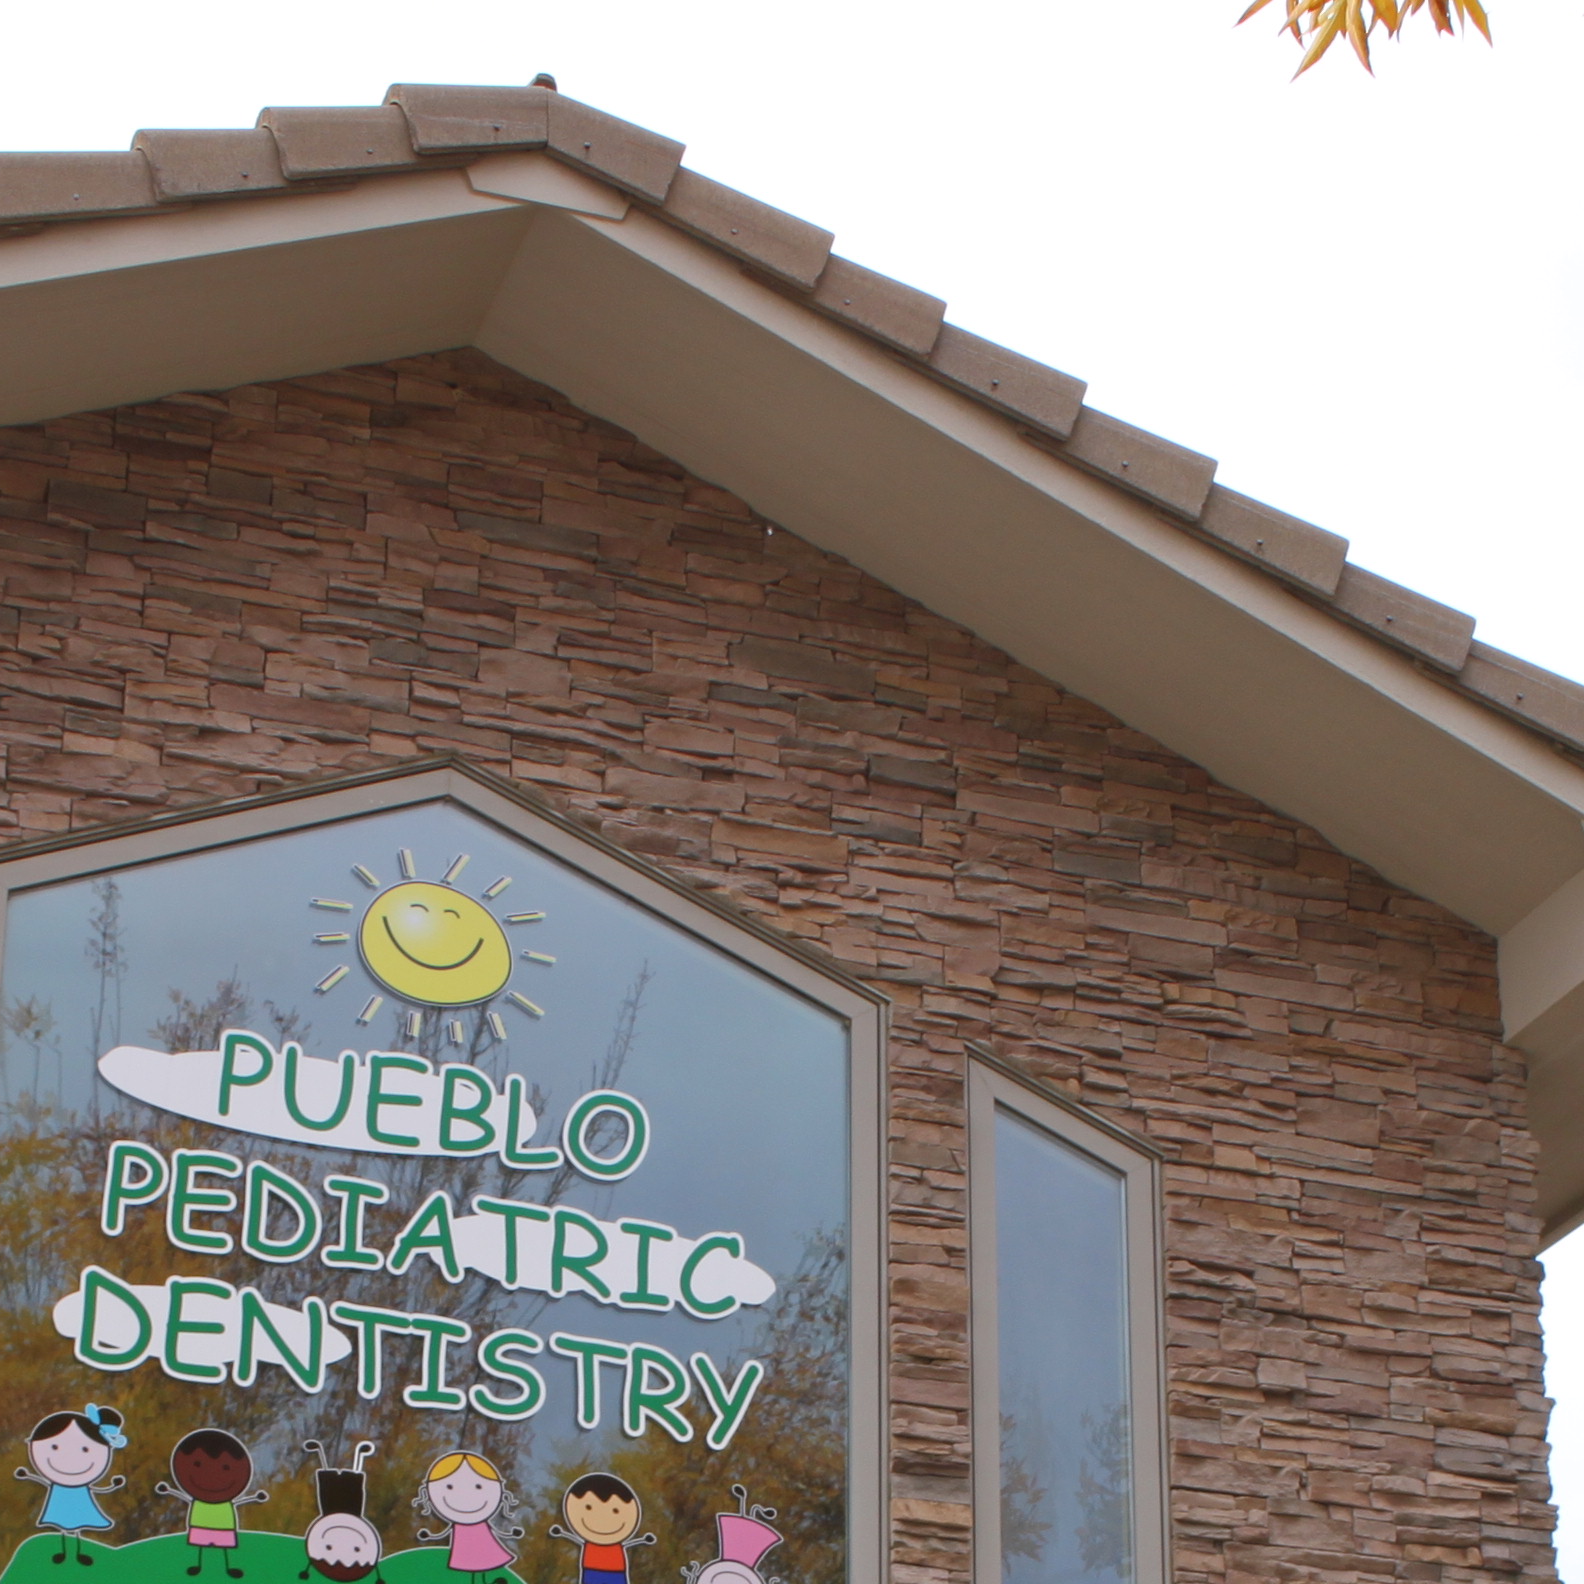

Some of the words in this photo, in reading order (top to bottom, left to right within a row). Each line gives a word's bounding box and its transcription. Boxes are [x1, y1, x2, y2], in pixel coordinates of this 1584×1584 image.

[216, 1030, 648, 1179] PUEBLO
[103, 1141, 745, 1319] PEDIATRIC
[74, 1265, 764, 1450] DENTISTRY
